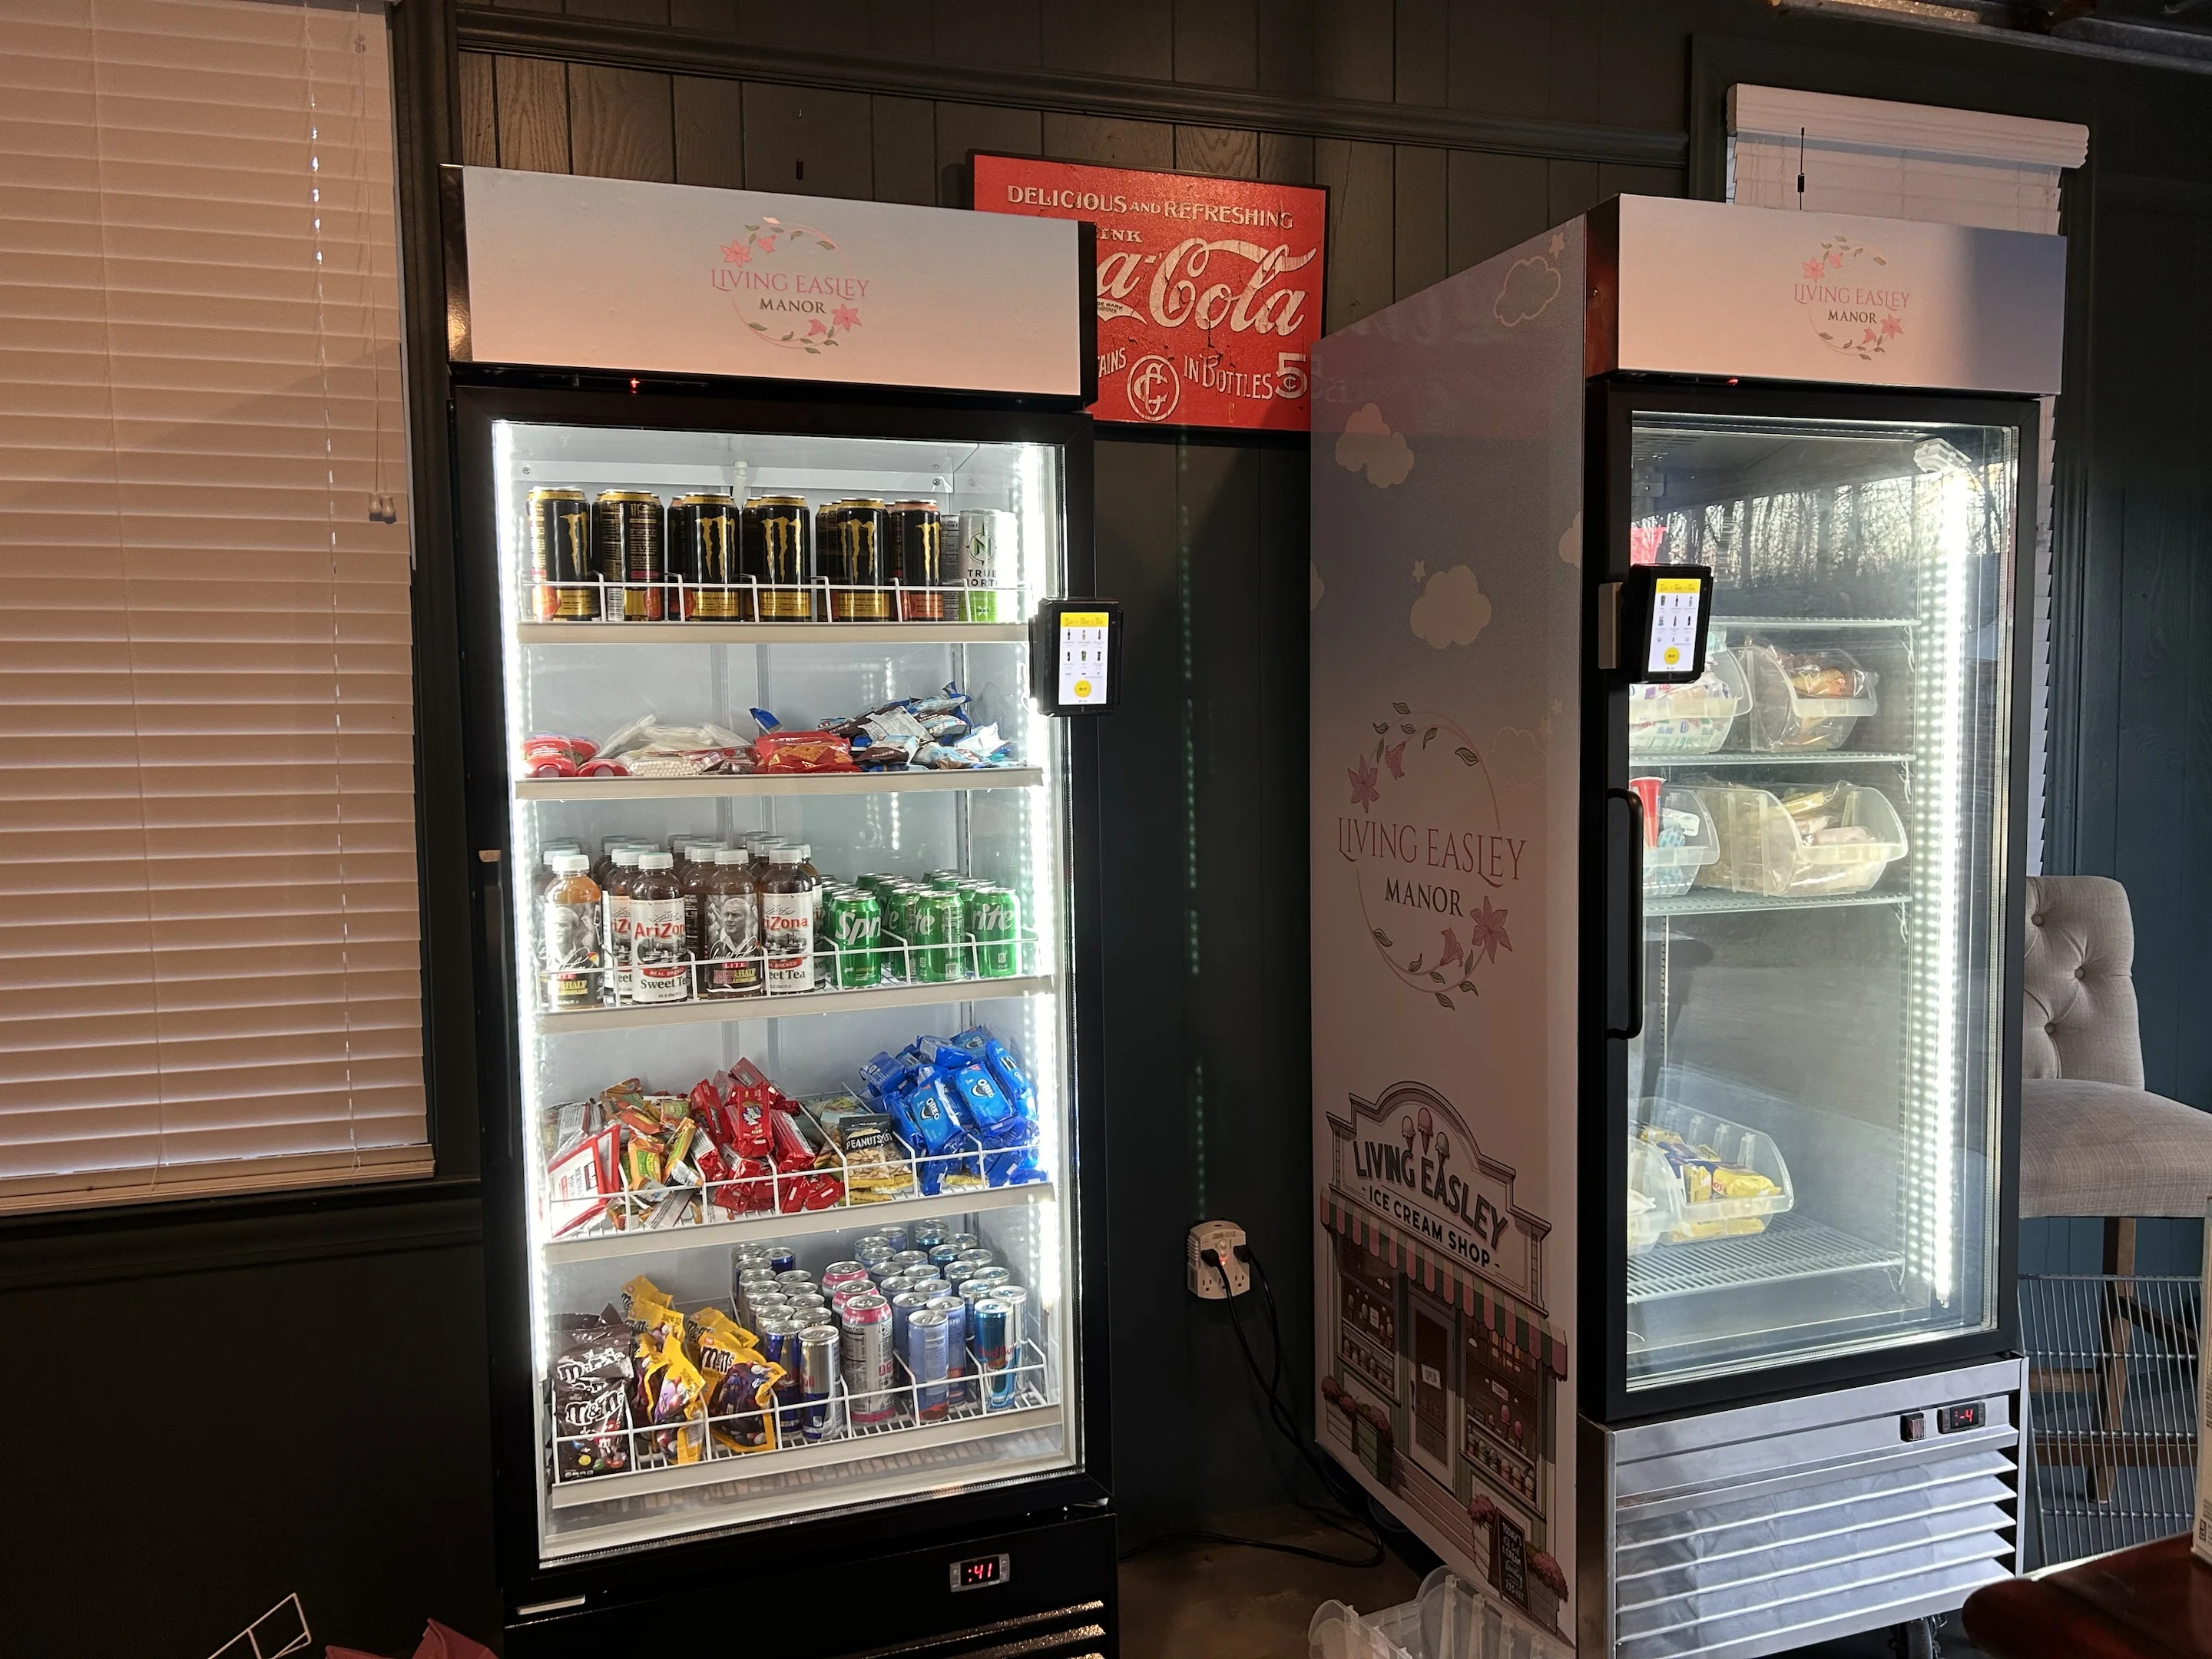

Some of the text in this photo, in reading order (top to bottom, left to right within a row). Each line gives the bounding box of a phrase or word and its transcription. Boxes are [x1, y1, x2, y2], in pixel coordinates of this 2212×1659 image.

[1008, 184, 1293, 230] DELICIOUS AND REFRESHING
[1097, 228, 1143, 243] INK
[710, 268, 869, 300] LIVING EASLEY
[759, 297, 826, 314] MANOR
[1794, 283, 1911, 311] LIVING EASLEY
[1827, 310, 1877, 323] MANOR
[1183, 356, 1199, 383] IN
[1200, 353, 1274, 400] BOTTLES
[967, 569, 997, 578] TRUE
[1338, 817, 1527, 888] LIVING EASLEY
[1384, 876, 1464, 917] MANOR
[634, 922, 686, 941] AriZon
[764, 916, 808, 932] iZona
[641, 979, 675, 989] Sweet
[786, 969, 805, 979] Tea
[978, 1078, 994, 1098] OREO
[926, 1097, 939, 1121] OREO
[846, 1134, 882, 1151] PEANUTS
[1353, 1141, 1508, 1250] LIVING EASLEY
[1369, 1185, 1491, 1268] ICE CREAM SHOP
